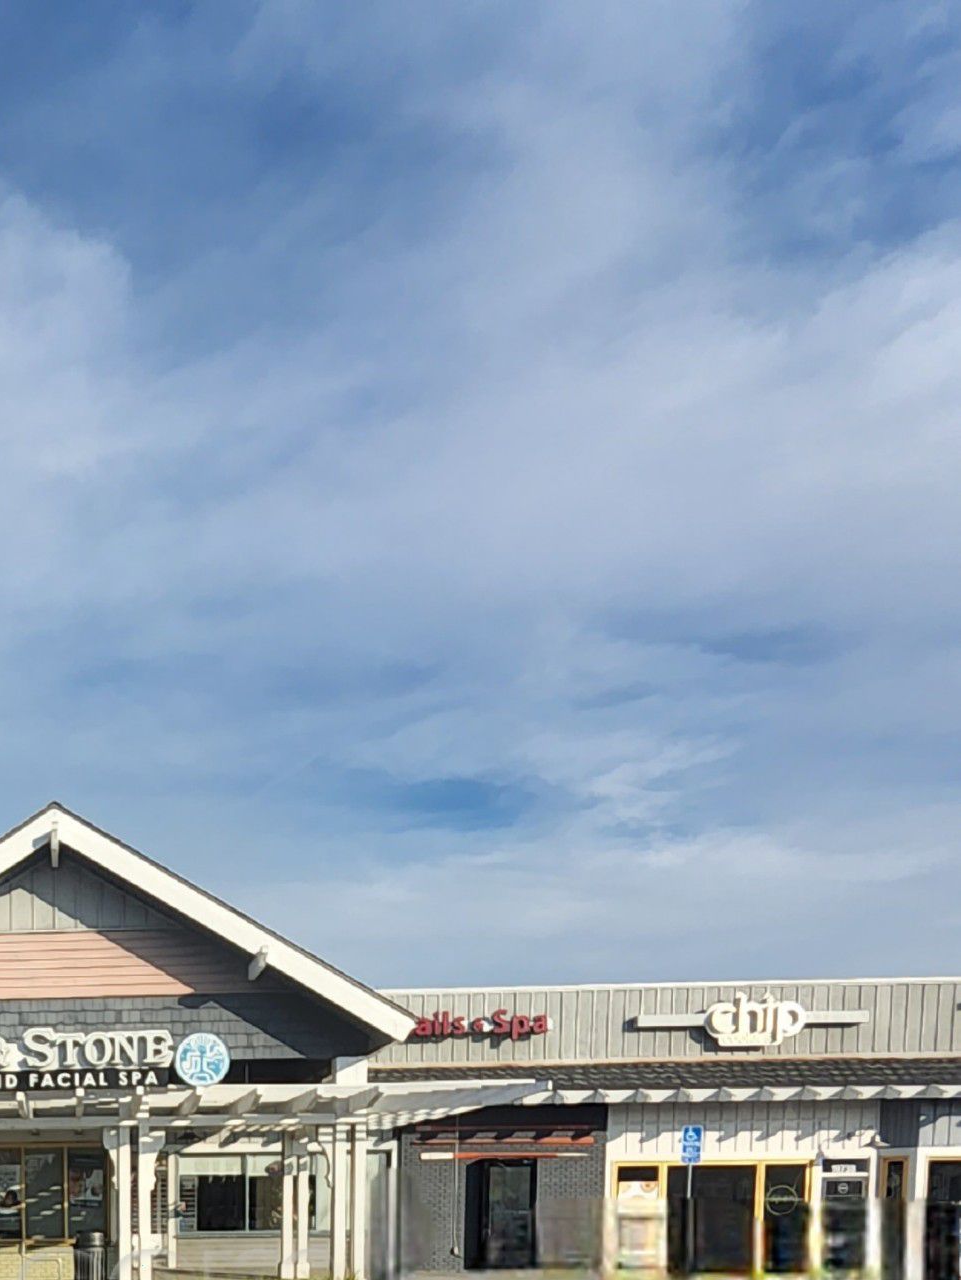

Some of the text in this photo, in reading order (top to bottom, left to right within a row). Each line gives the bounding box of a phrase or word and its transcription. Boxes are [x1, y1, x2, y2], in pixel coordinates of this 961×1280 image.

[414, 1009, 548, 1040] ails Spa
[23, 1027, 173, 1069] STONE
[29, 1071, 108, 1087] FACIAL
[118, 1070, 158, 1086] SPA
